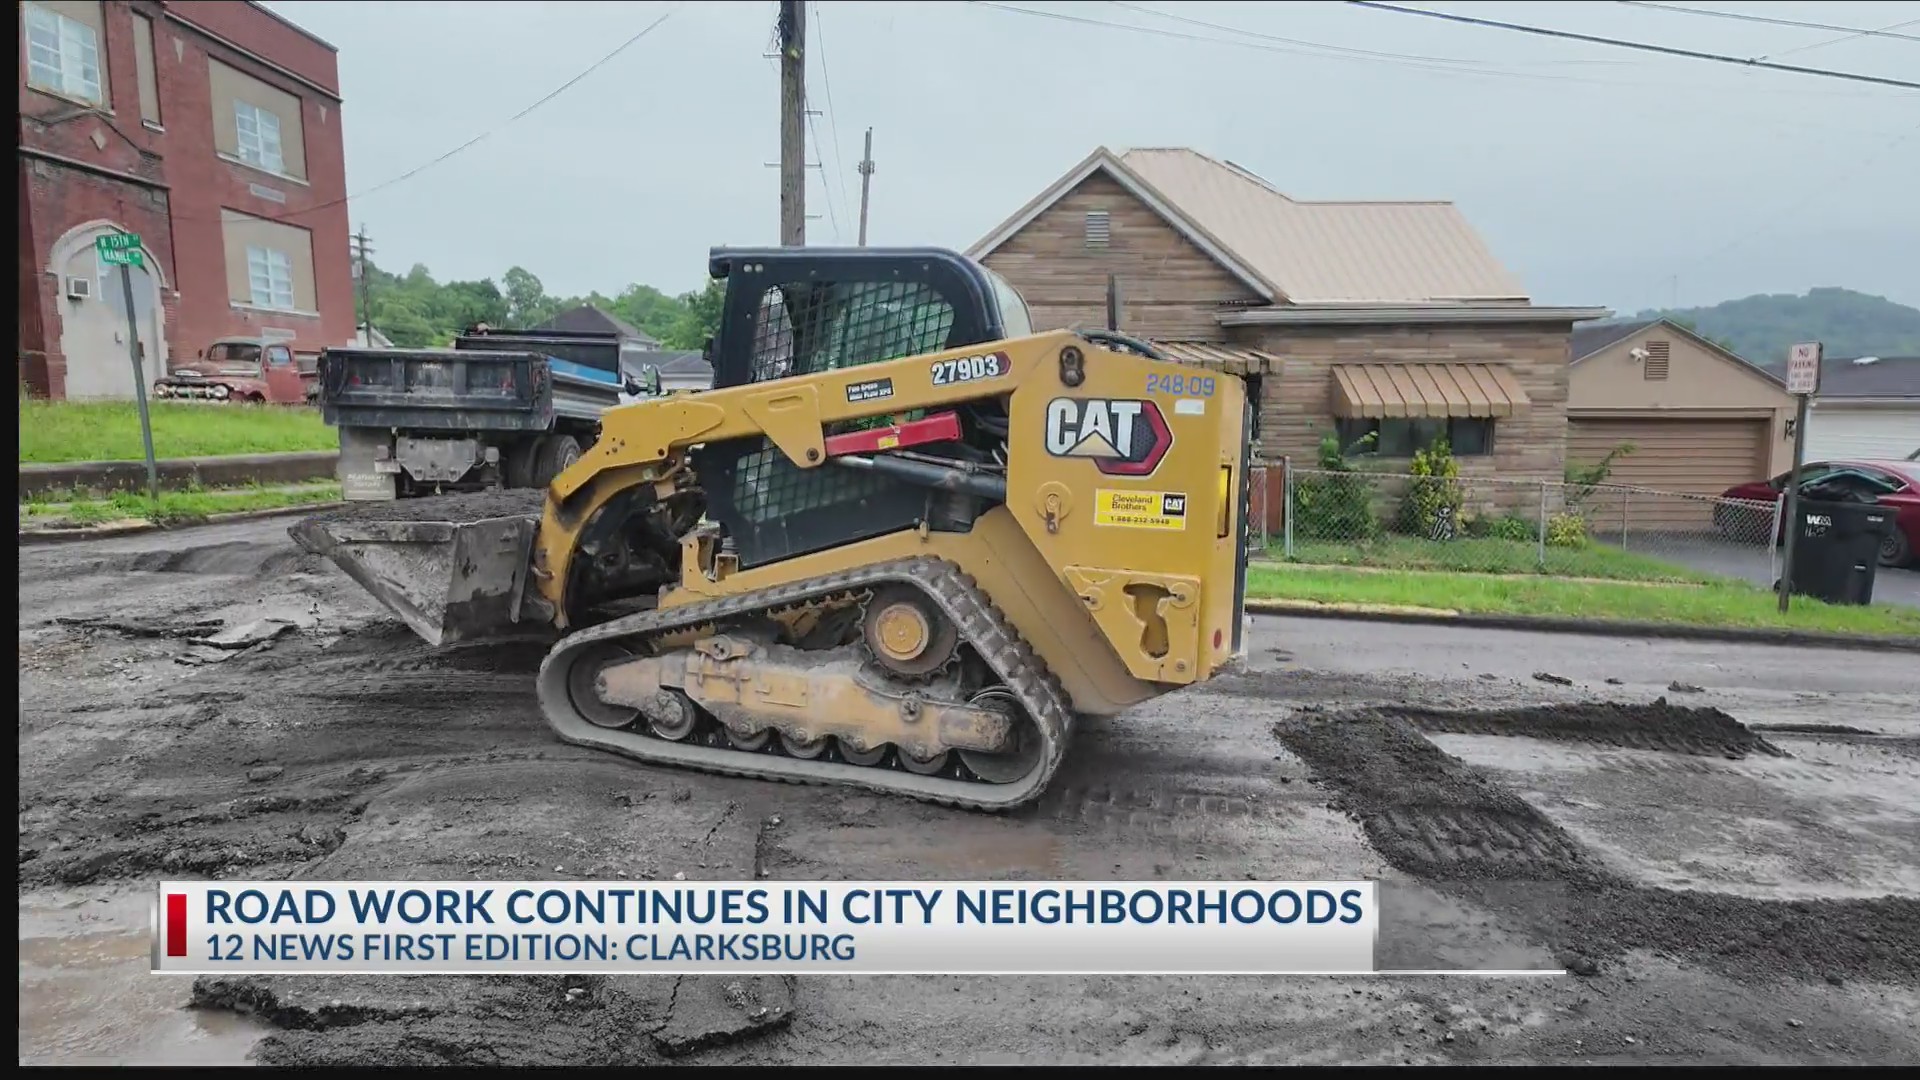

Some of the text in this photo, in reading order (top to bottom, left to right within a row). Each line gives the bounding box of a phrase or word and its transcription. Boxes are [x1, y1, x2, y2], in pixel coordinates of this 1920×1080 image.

[111, 234, 130, 247] 15TH
[1798, 347, 1809, 358] NO
[931, 353, 999, 386] 279D3
[1790, 360, 1816, 369] PARKING
[1146, 373, 1215, 396] 248-09
[1047, 397, 1142, 458] CAT
[1112, 493, 1153, 504] Cleveland
[1165, 498, 1184, 511] CAT
[1112, 501, 1147, 511] Brothers
[1806, 514, 1832, 526] WM
